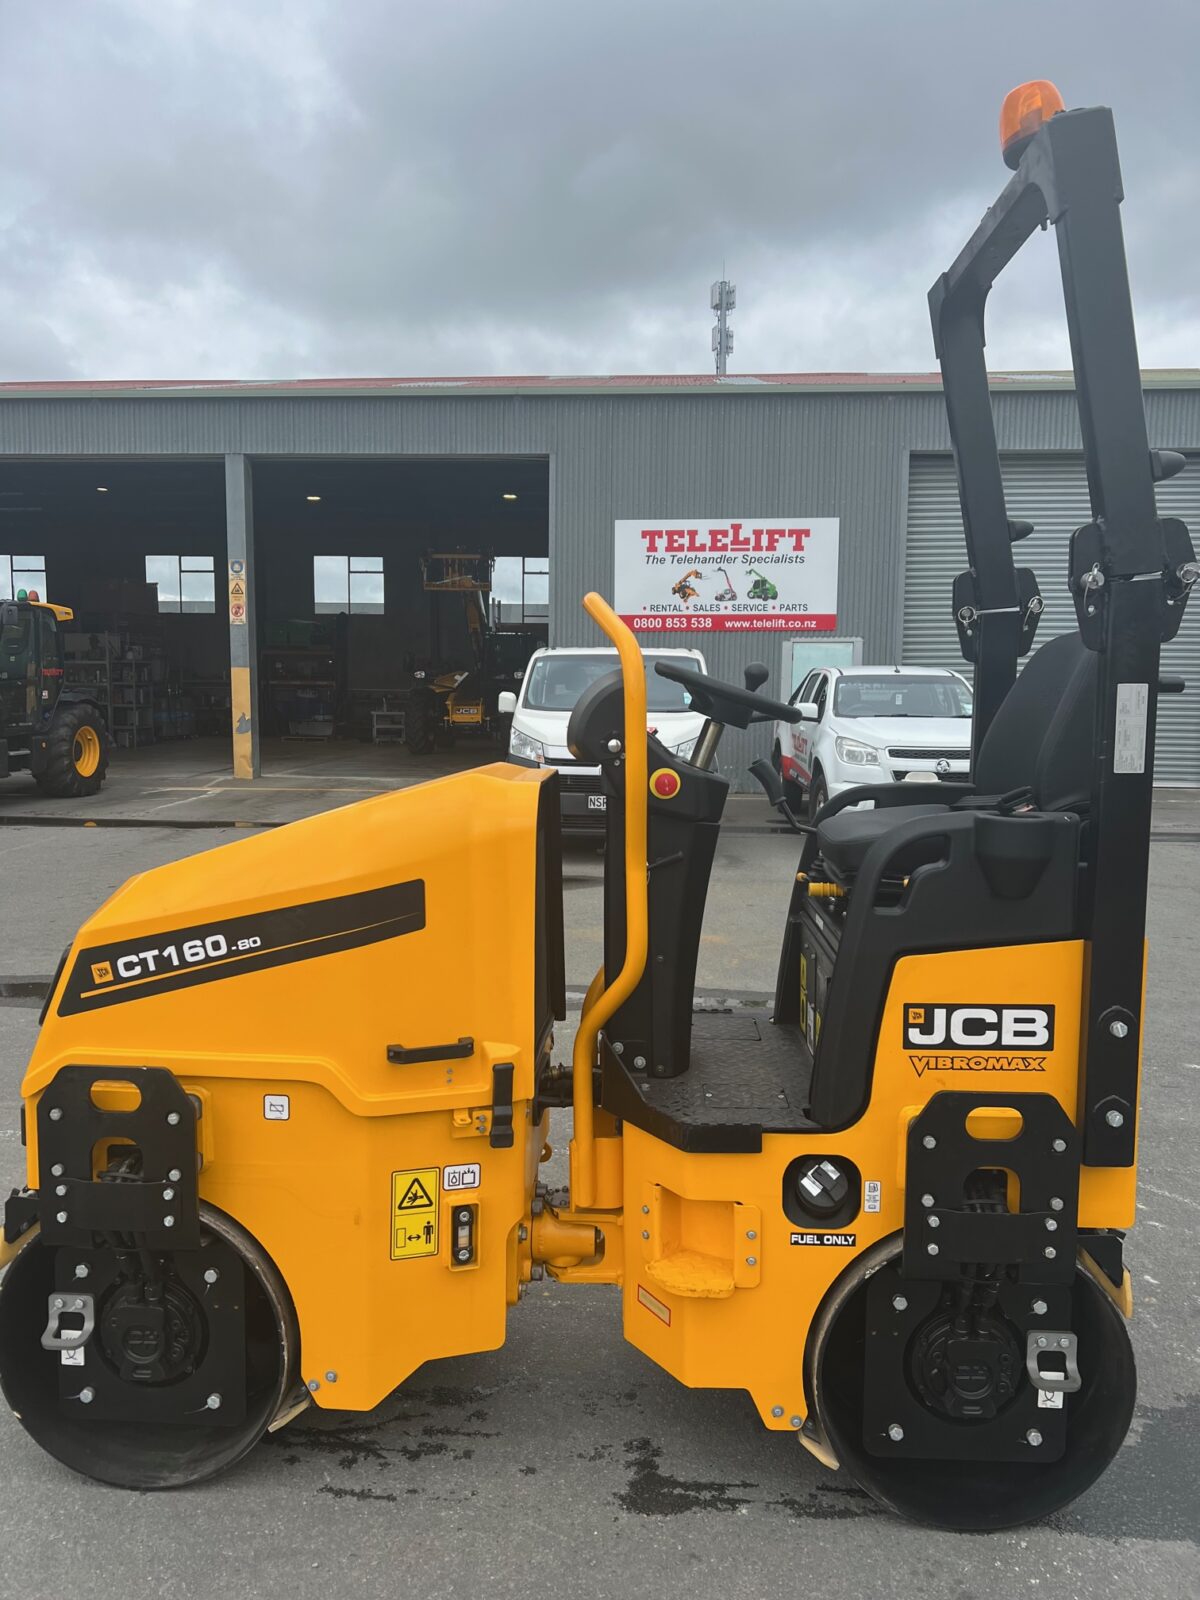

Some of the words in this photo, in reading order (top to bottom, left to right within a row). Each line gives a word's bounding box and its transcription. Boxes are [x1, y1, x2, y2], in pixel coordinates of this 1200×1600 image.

[641, 523, 811, 552] TELELIFT
[645, 555, 666, 565] The
[670, 554, 738, 565] Telehandler
[741, 554, 805, 566] Specialists
[650, 604, 684, 612] RENTAL
[693, 604, 721, 612] SALES
[731, 604, 769, 612] SERVICE
[633, 618, 662, 628] 0800
[665, 618, 687, 628] 853
[690, 618, 712, 628] 538
[725, 618, 817, 628] www.telelift.co.nz
[908, 1008, 1049, 1046] JCB
[909, 1056, 1046, 1078] VIBROMAX
[791, 1234, 821, 1244] FUEL
[823, 1235, 855, 1245] ONLY
